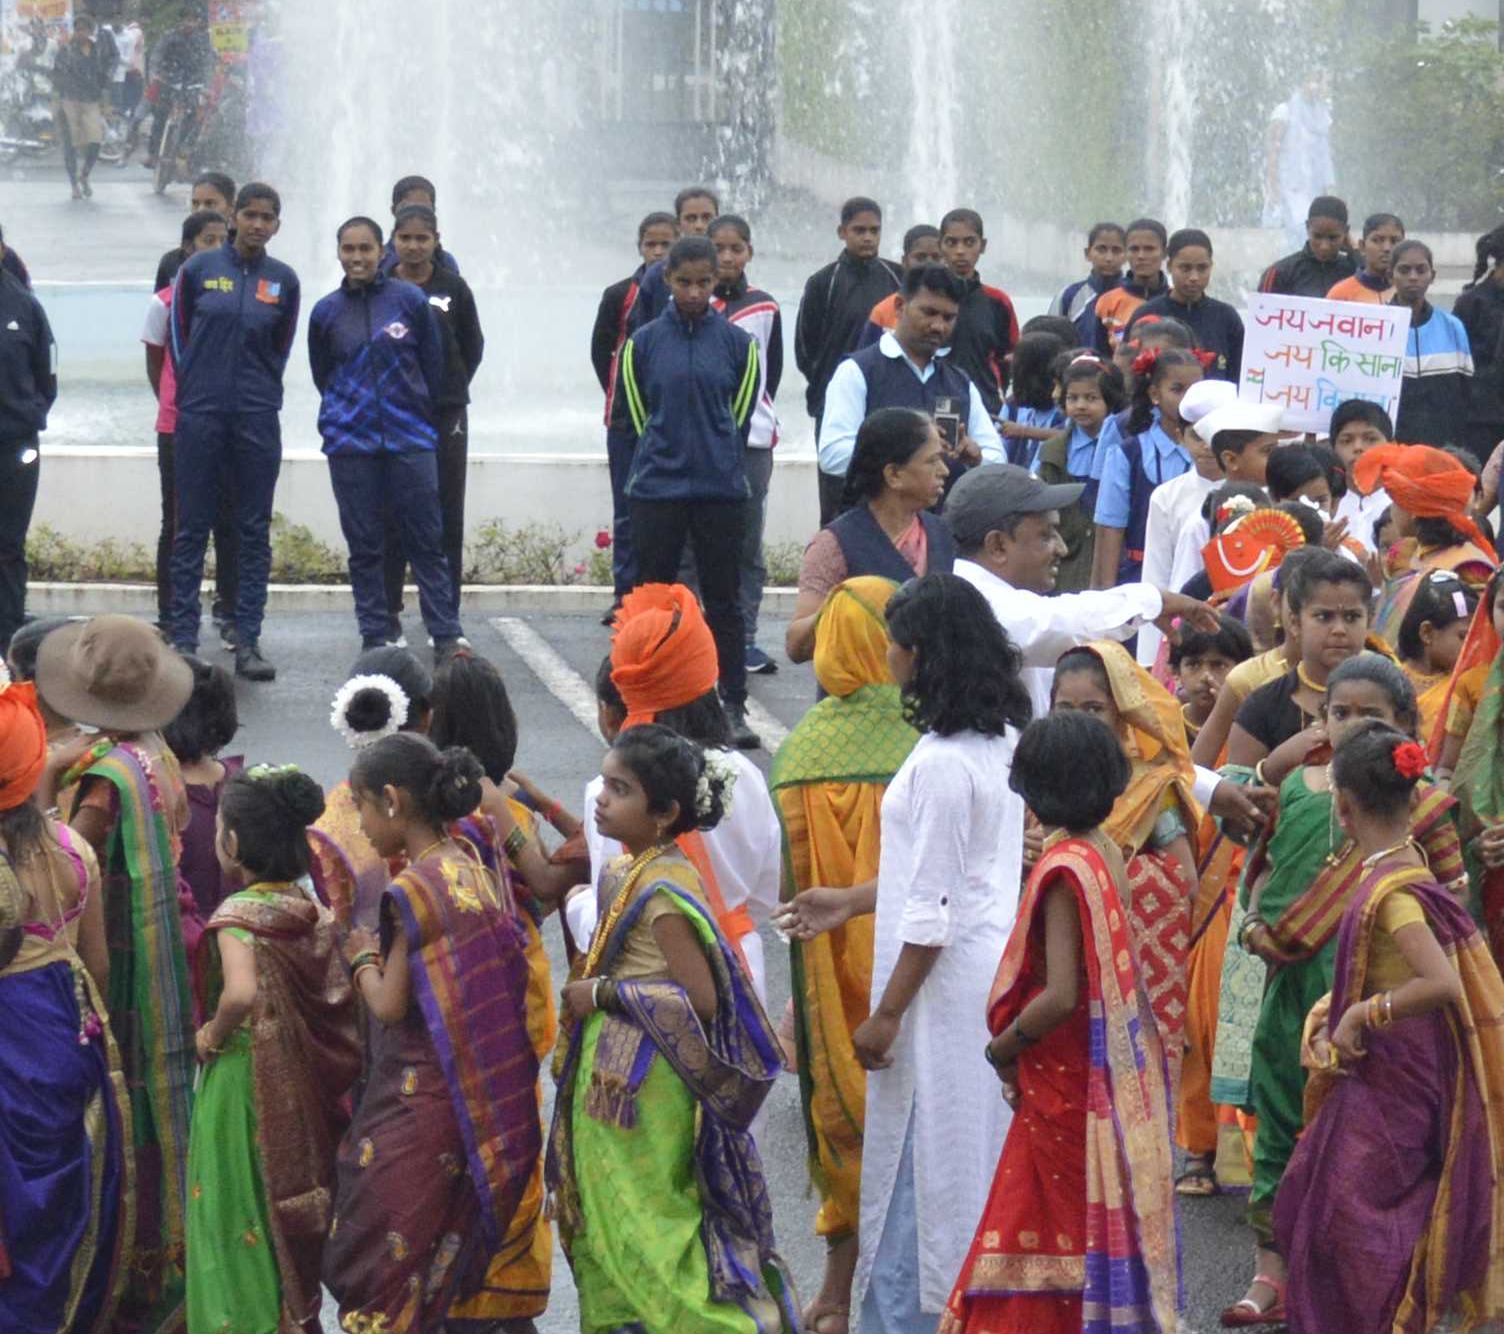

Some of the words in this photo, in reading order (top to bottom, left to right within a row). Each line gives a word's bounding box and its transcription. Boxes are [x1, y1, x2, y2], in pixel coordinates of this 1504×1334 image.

[1255, 308, 1306, 332] जय
[1264, 345, 1314, 370] जय
[1264, 385, 1312, 411] जय
